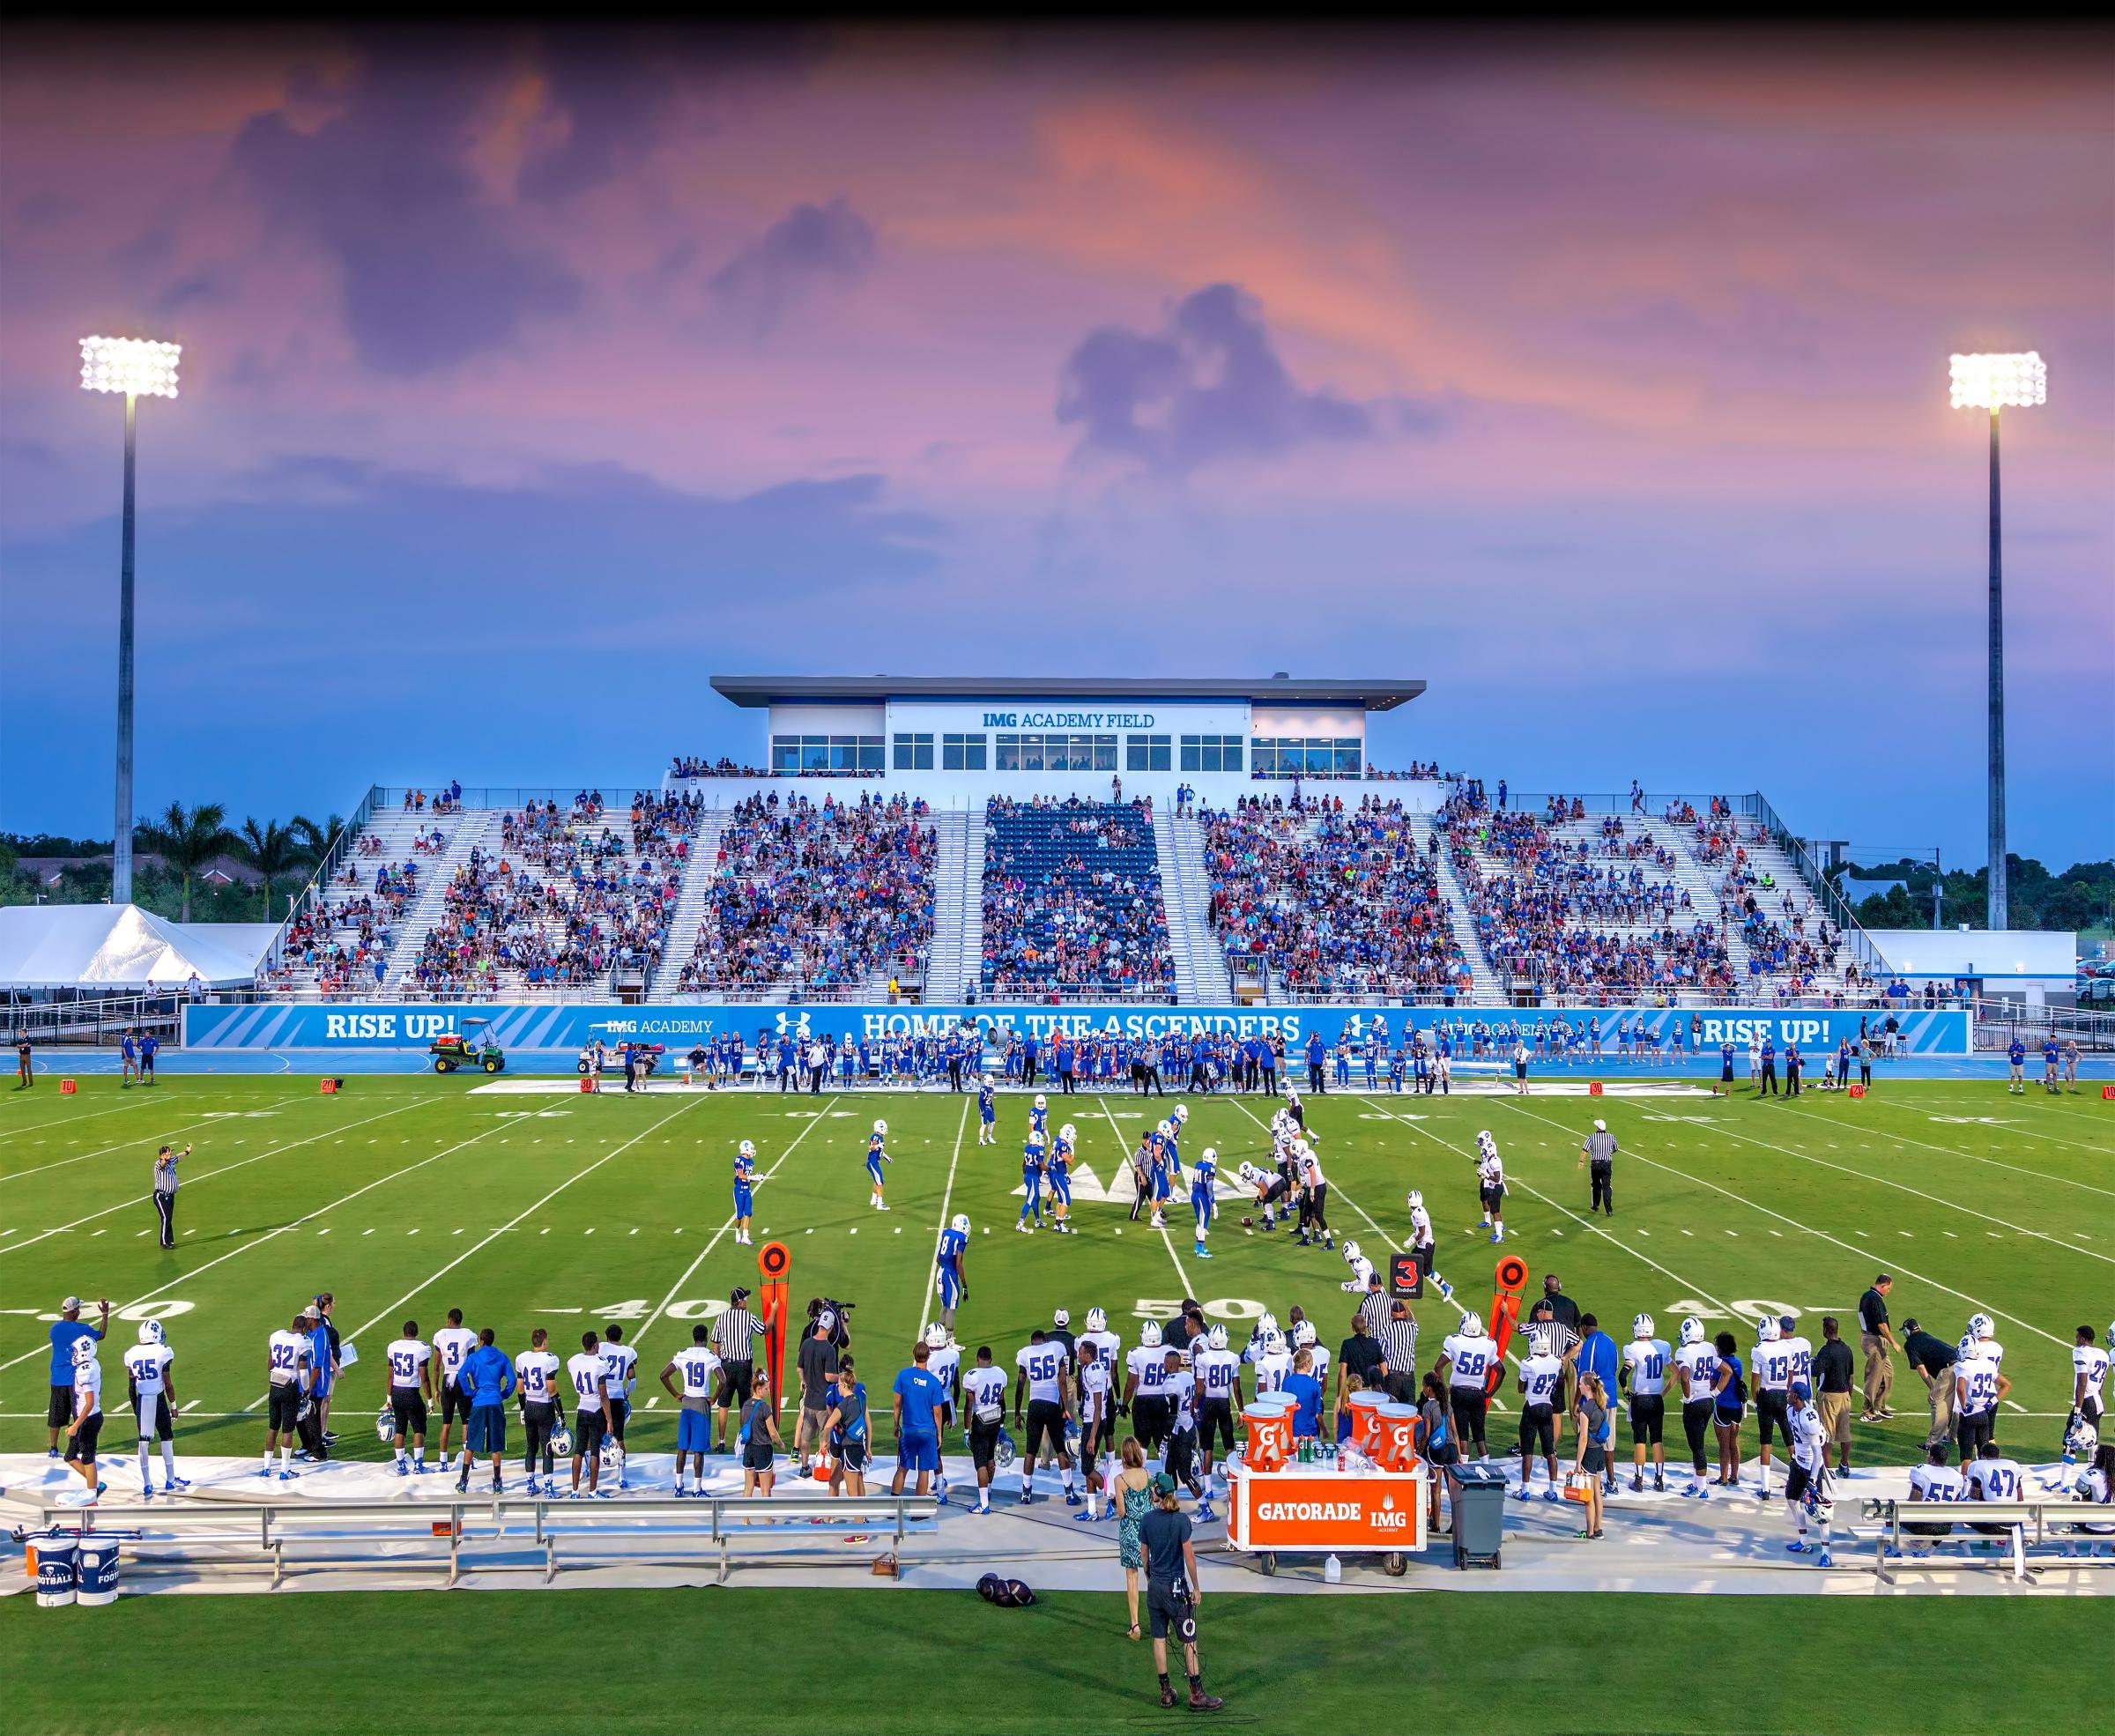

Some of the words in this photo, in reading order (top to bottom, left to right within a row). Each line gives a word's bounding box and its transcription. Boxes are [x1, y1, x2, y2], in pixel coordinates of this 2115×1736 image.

[983, 713, 1016, 727] IMG
[1020, 713, 1104, 728] ACADEMY
[1106, 714, 1155, 728] FIELD
[326, 1014, 397, 1038] RISE
[404, 1014, 455, 1038] UP!
[640, 1020, 713, 1033] ACADEMY
[863, 1014, 961, 1040] HOME
[1025, 1015, 1091, 1040] THE
[1104, 1015, 1300, 1042] ASCENDERS
[1703, 1020, 1772, 1042] RISE
[1780, 1020, 1829, 1043] UP!
[63, 1080, 73, 1091] 10
[322, 1080, 333, 1090] 20
[581, 1079, 591, 1088] 30
[1592, 1082, 1602, 1093] 30
[1853, 1085, 1864, 1095] 20
[940, 1235, 950, 1255] 8
[1395, 1261, 1418, 1287] 3
[589, 1299, 732, 1320] 40
[1663, 1299, 1803, 1319] 40
[272, 1344, 295, 1369] 32
[393, 1352, 414, 1377] 53
[447, 1341, 460, 1366] 3
[1456, 1351, 1485, 1376] 58
[132, 1358, 159, 1381] 35
[605, 1354, 627, 1381] 21
[686, 1361, 705, 1388] 19
[939, 1362, 955, 1390] 31
[1028, 1354, 1056, 1382] 56
[1208, 1363, 1232, 1388] 80
[1644, 1354, 1663, 1380] 10
[1768, 1355, 1788, 1382] 13
[575, 1370, 594, 1395] 41
[1532, 1373, 1557, 1395] 87
[979, 1383, 1002, 1406] 48
[1368, 1415, 1381, 1434] G
[1807, 1410, 1817, 1421] 25
[1259, 1426, 1275, 1446] G
[1393, 1427, 1408, 1445] G
[1926, 1482, 1955, 1502] 55
[1988, 1469, 2015, 1497] 47
[1258, 1502, 1362, 1521] GATORADE
[1370, 1511, 1406, 1527] IMG
